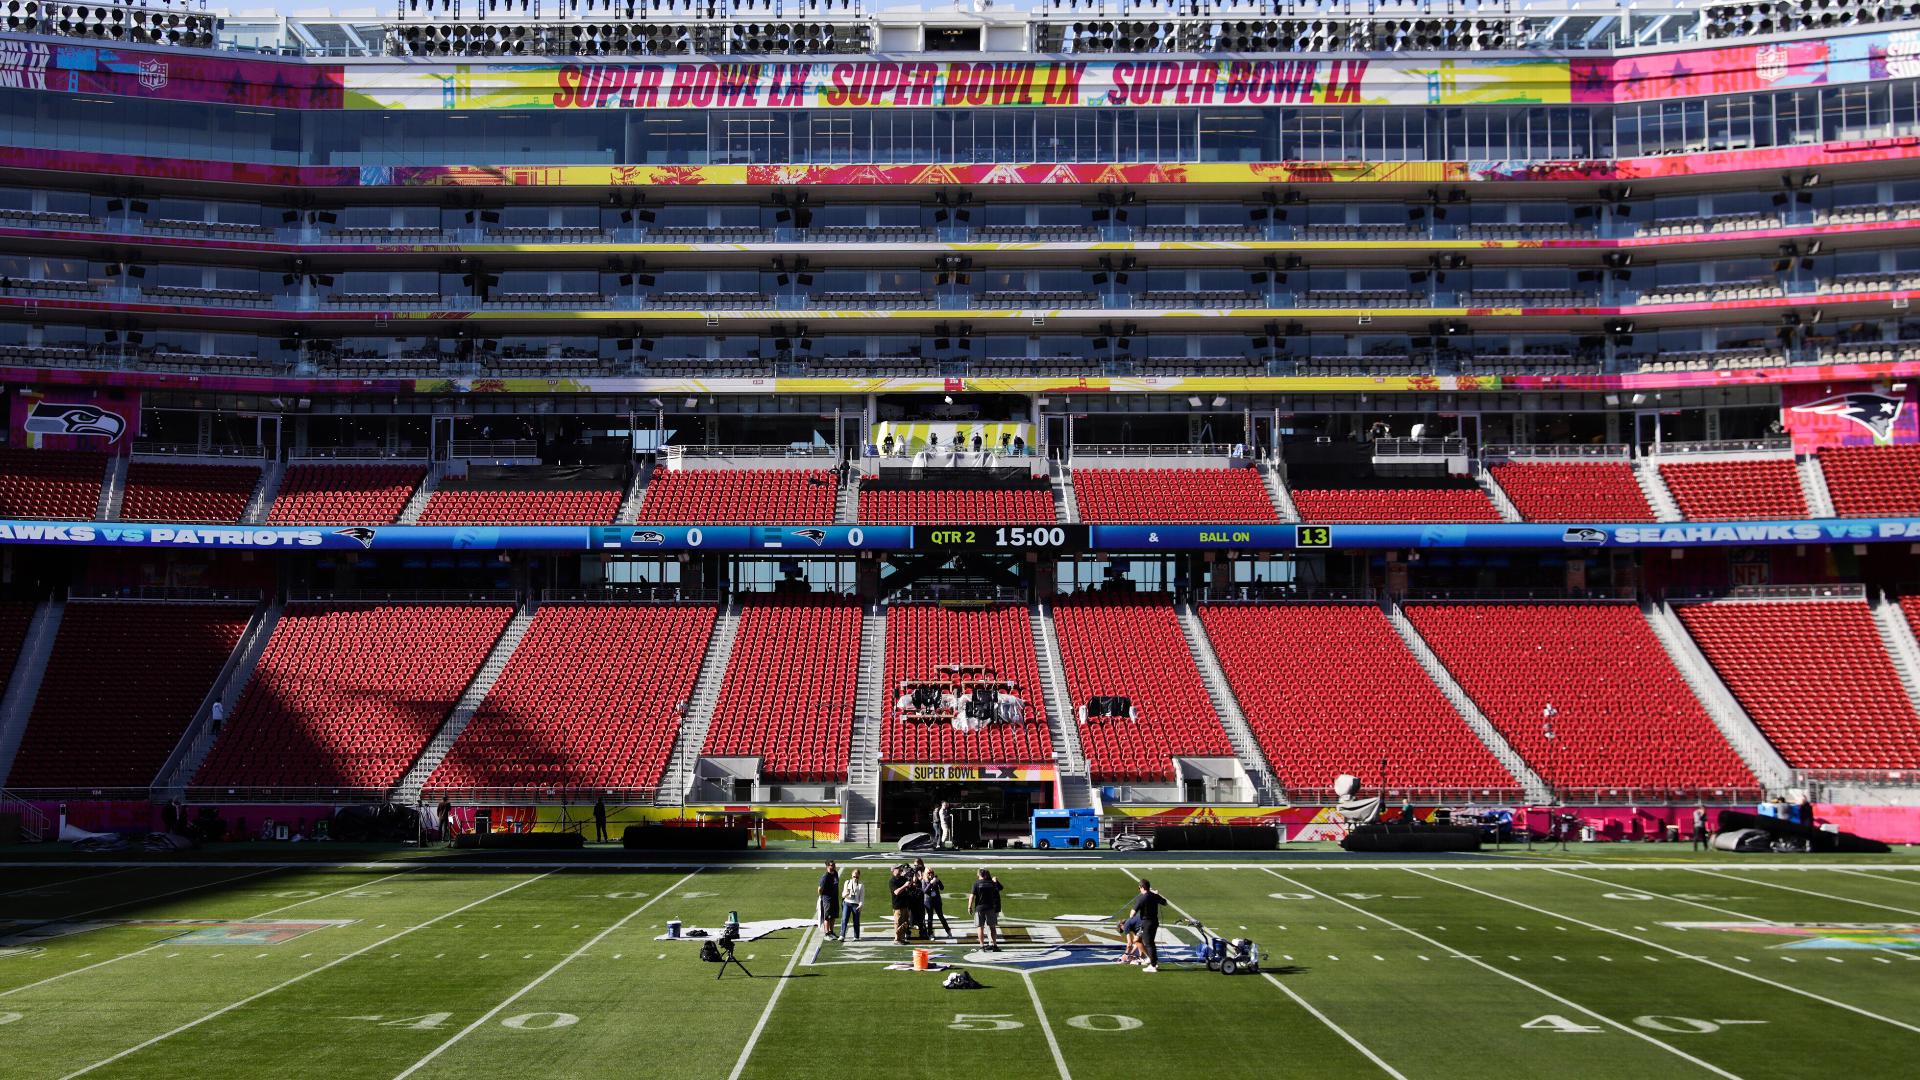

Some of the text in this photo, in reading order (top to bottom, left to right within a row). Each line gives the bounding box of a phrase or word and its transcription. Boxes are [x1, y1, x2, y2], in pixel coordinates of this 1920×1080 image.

[553, 60, 1369, 107] SUPER BOWL LX SUPER BOWL LX SUPER BOWL LX
[0, 524, 323, 545] AWKS VS PATRIOTS
[687, 528, 703, 547] 0
[847, 528, 864, 547] 0
[931, 531, 976, 545] QTR 2
[995, 527, 1065, 546] 15:00
[1148, 532, 1160, 543] &
[1199, 532, 1250, 542] BALL ON
[1302, 528, 1328, 544] 13
[1614, 524, 1821, 543] SEAHAWKS
[1827, 523, 1872, 539] VS
[914, 767, 1019, 779] SUPER BOWL LX
